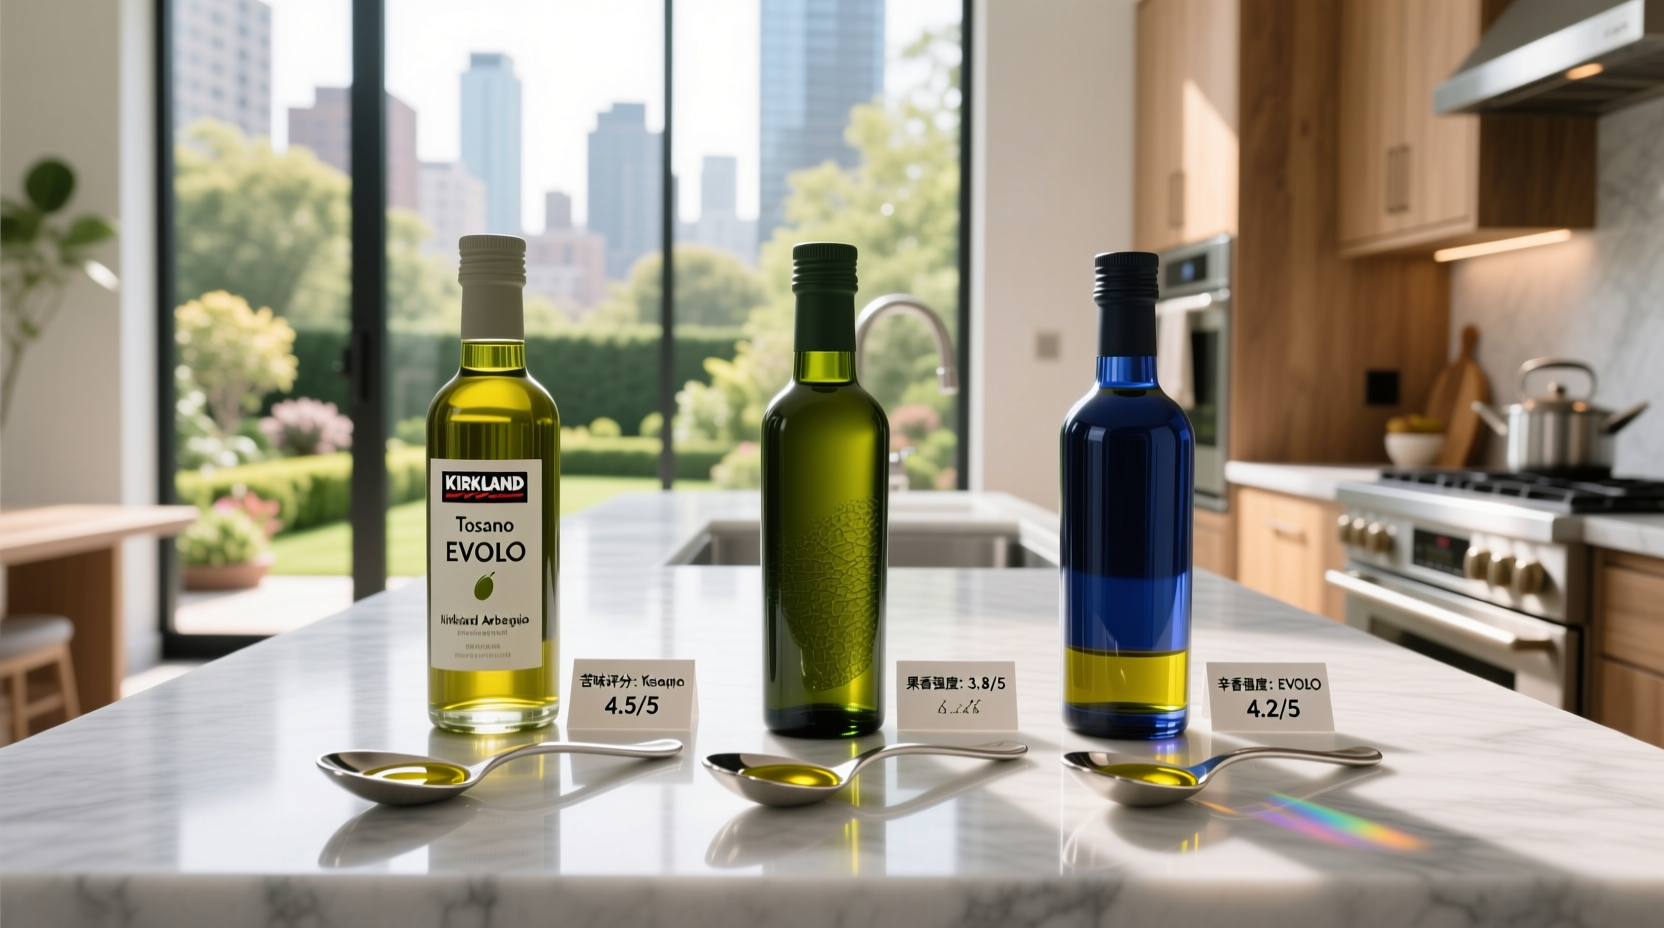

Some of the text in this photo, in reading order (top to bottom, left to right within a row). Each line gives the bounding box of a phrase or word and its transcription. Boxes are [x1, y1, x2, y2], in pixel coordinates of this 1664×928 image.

[445, 474, 525, 492] KIRKLAND
[455, 516, 515, 533] Tosano
[446, 541, 526, 562] EVOLO
[1278, 677, 1322, 691] EVOLO
[604, 695, 659, 716] 4.5/5
[1246, 698, 1300, 720] 4.2/5
